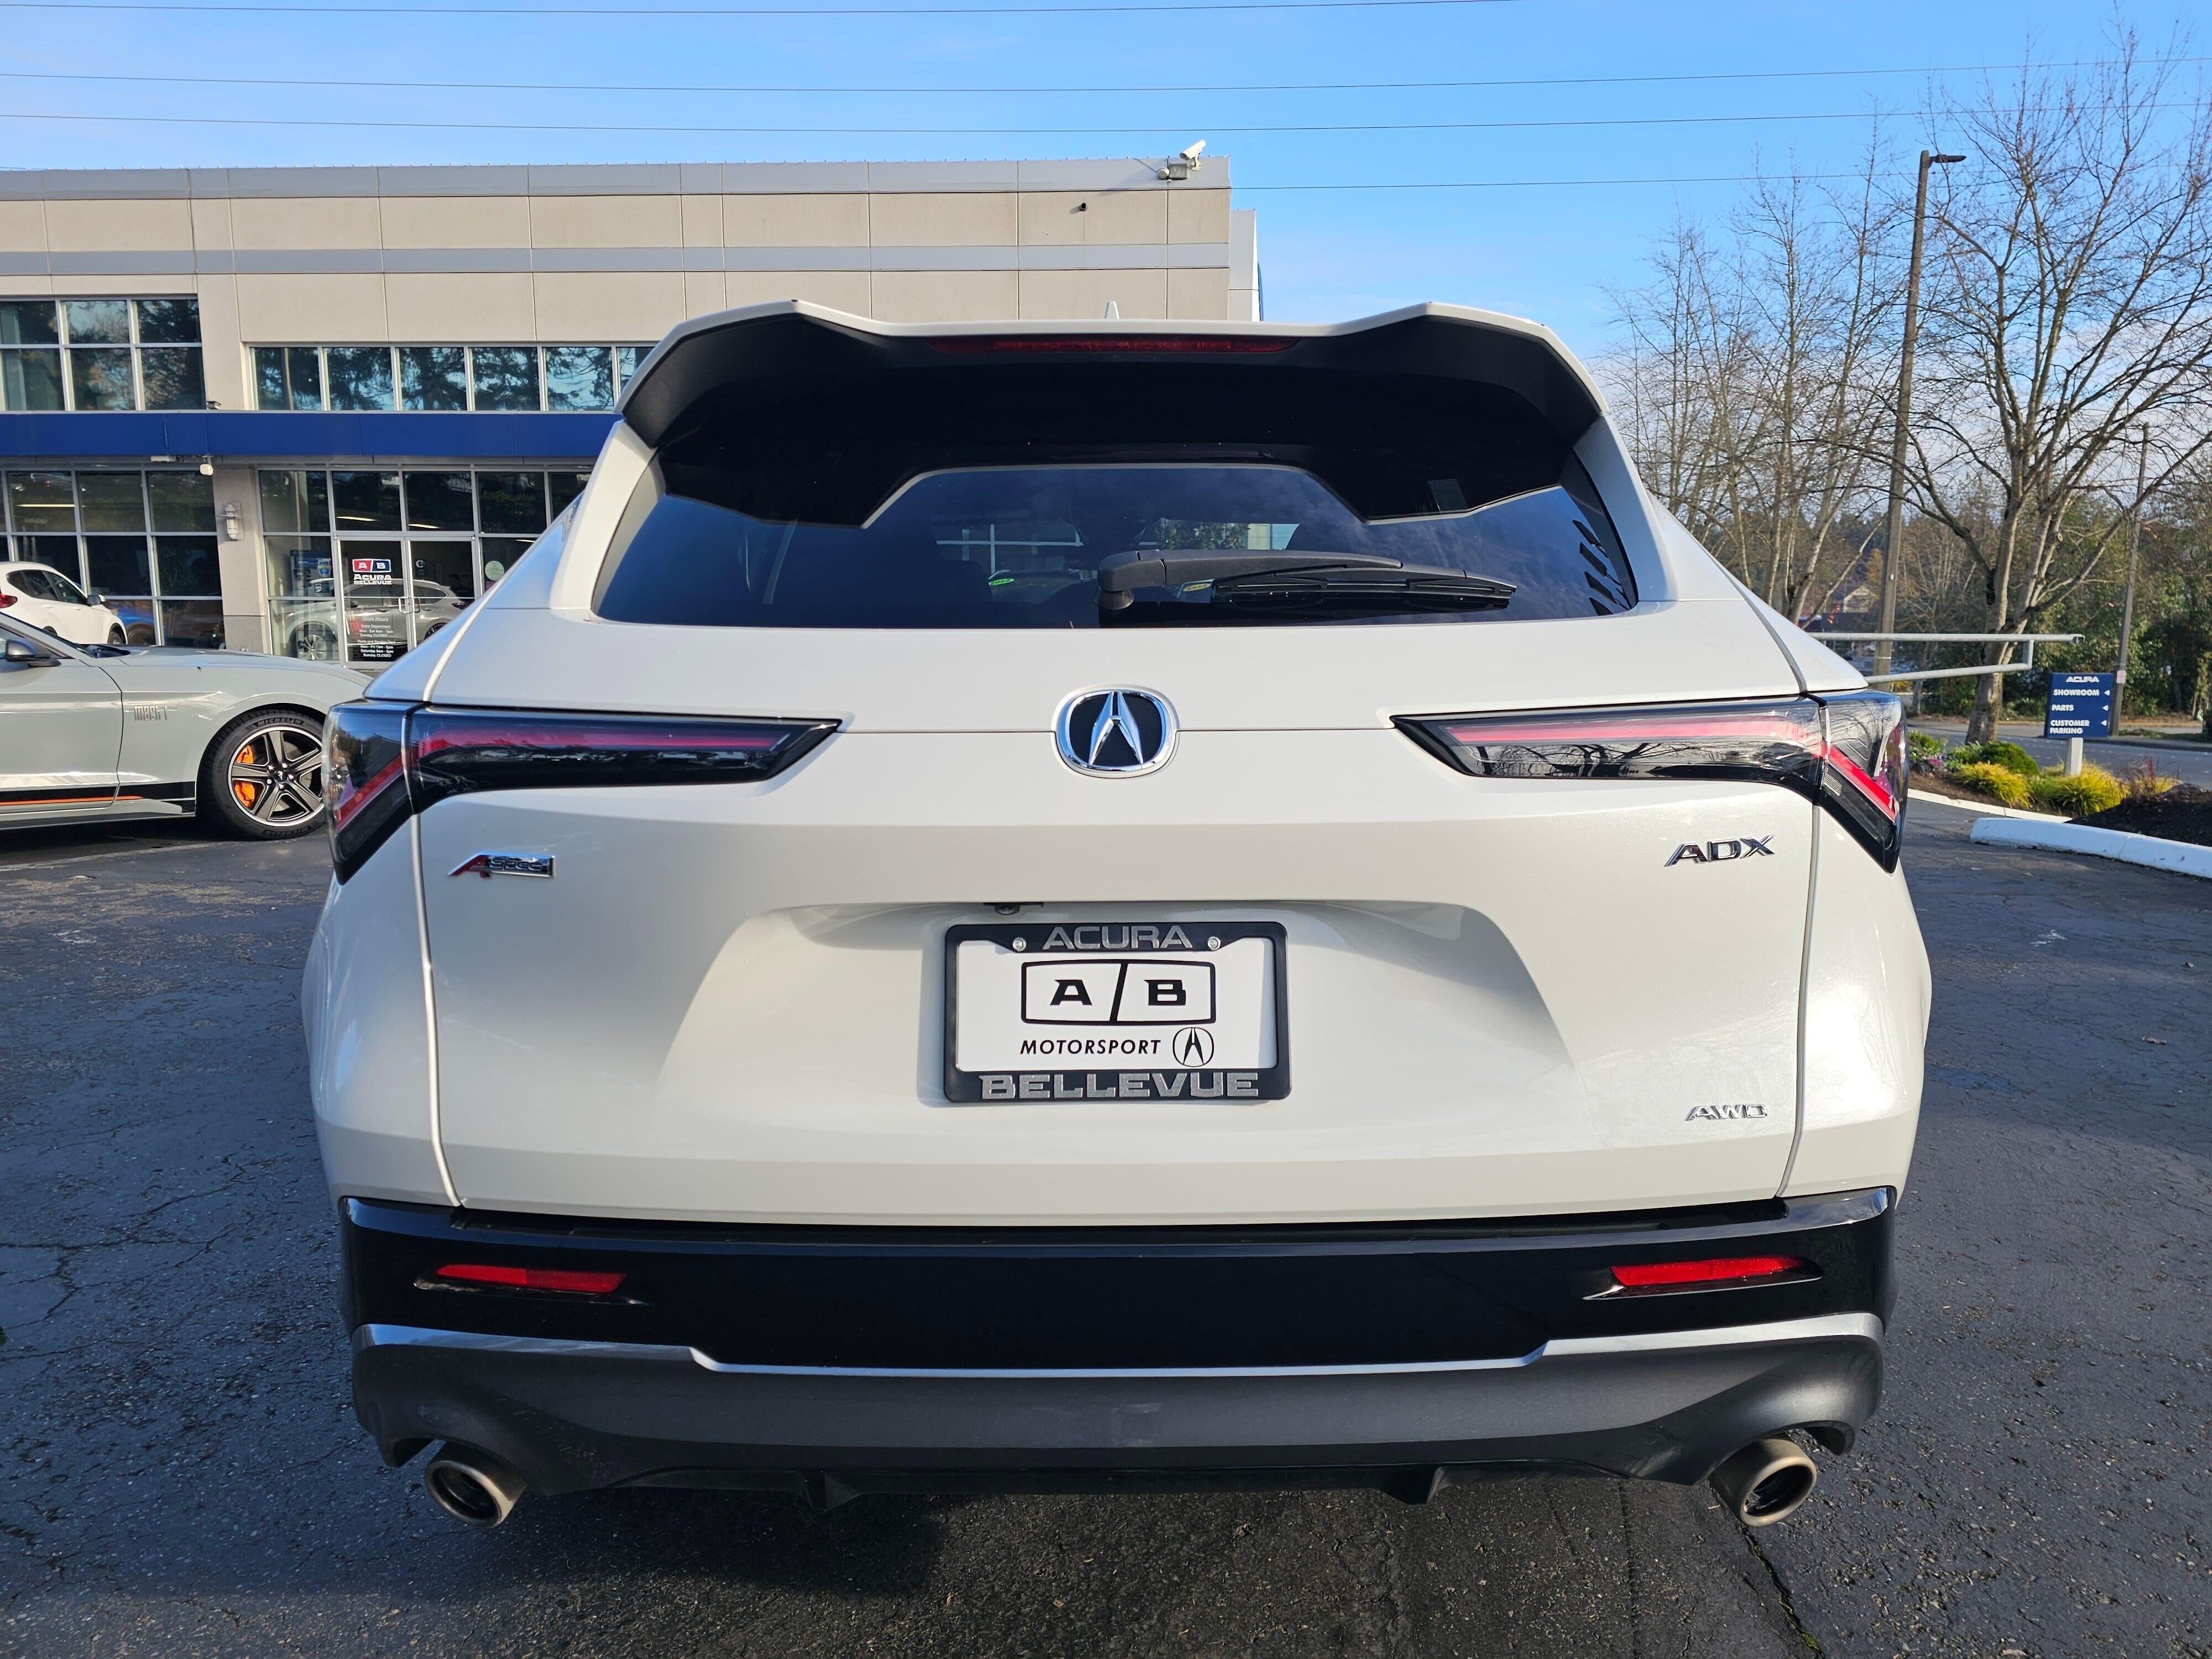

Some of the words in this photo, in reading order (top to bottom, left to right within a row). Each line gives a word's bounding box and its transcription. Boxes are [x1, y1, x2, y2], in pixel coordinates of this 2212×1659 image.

[257, 717, 302, 726] MICHELIN
[1664, 834, 1775, 867] ADX
[1042, 925, 1192, 950] ACURA
[1050, 979, 1093, 1005] A
[1143, 979, 1186, 1005] B
[1020, 1039, 1161, 1055] MOTORSPORT
[978, 1072, 1259, 1099] BELLEVUE
[1684, 1104, 1769, 1121] AWD
